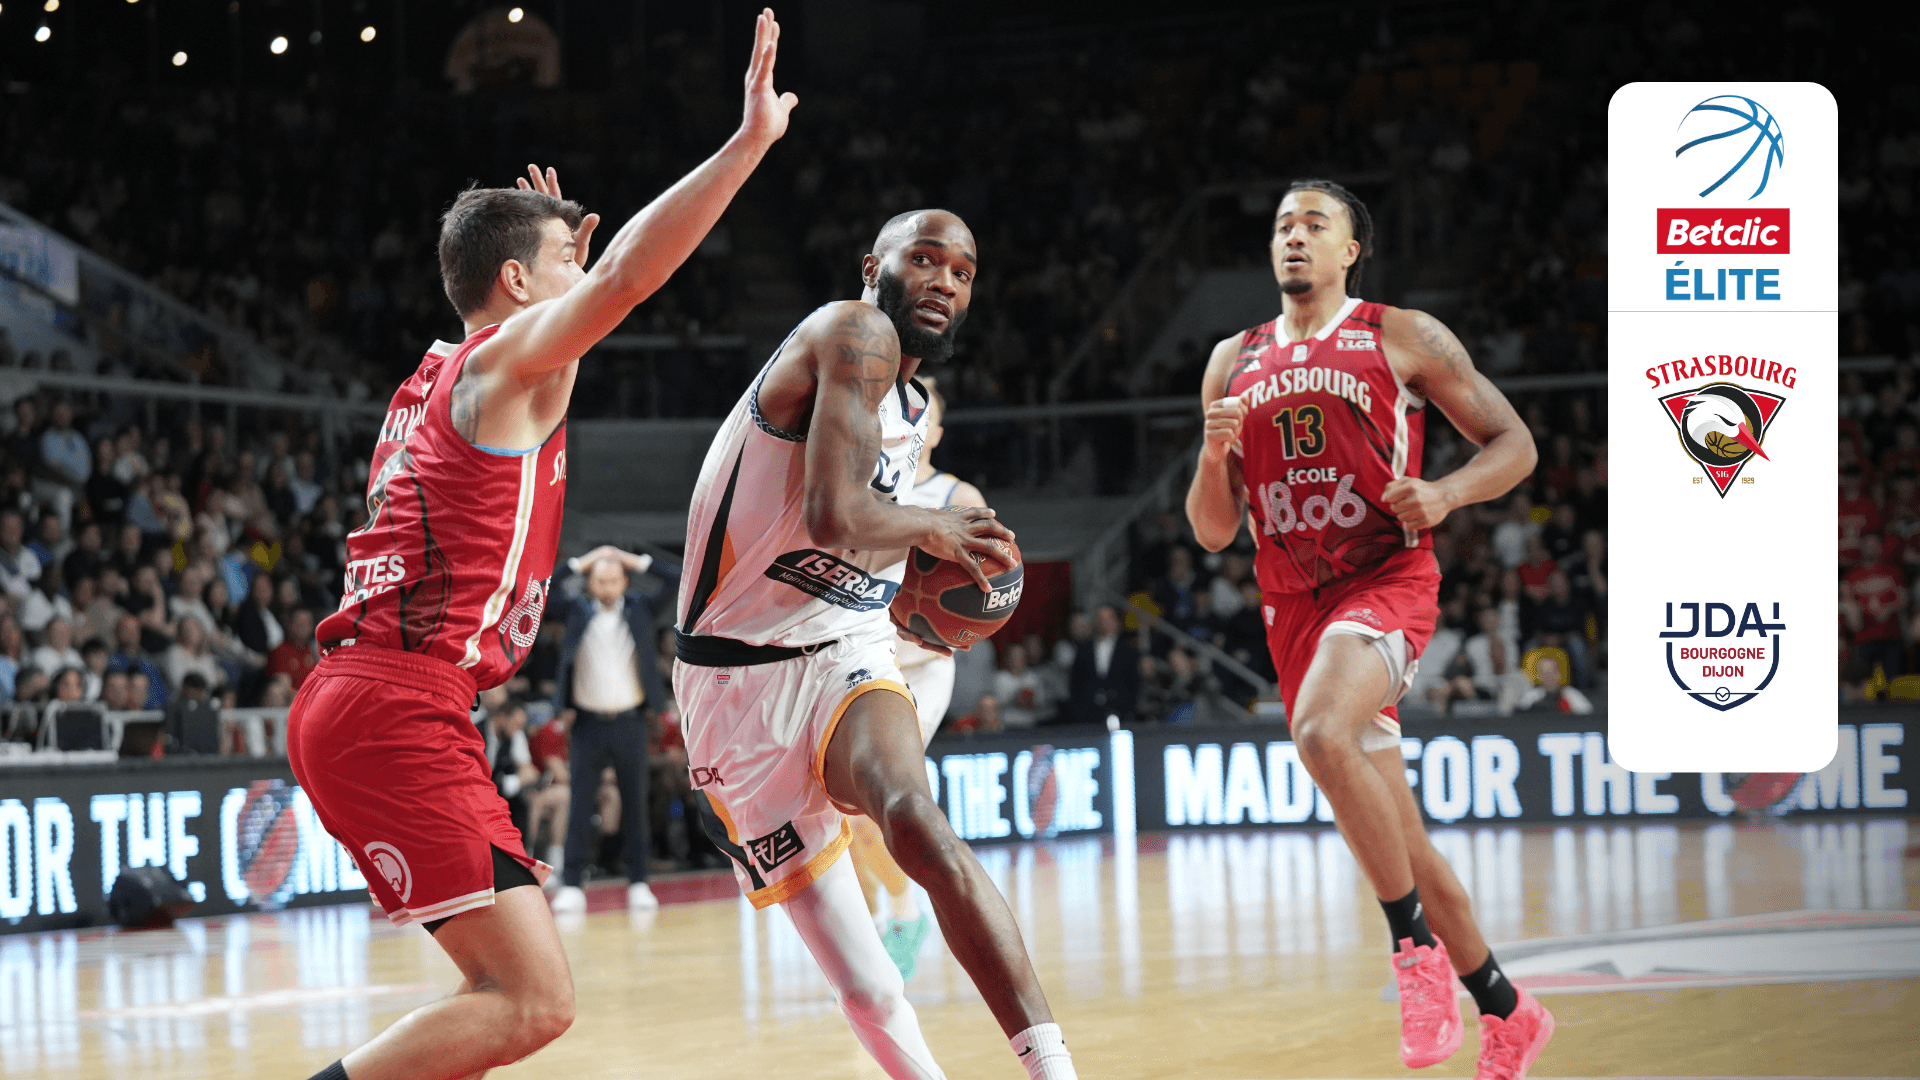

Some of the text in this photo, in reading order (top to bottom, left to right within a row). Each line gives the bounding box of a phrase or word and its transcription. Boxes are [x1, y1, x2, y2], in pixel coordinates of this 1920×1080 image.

[1240, 367, 1372, 413] RASBOURG
[1273, 404, 1326, 460] 13
[1286, 467, 1337, 485] ÉCOLE
[1258, 474, 1367, 536] 18.06
[795, 554, 886, 600] ISERBA
